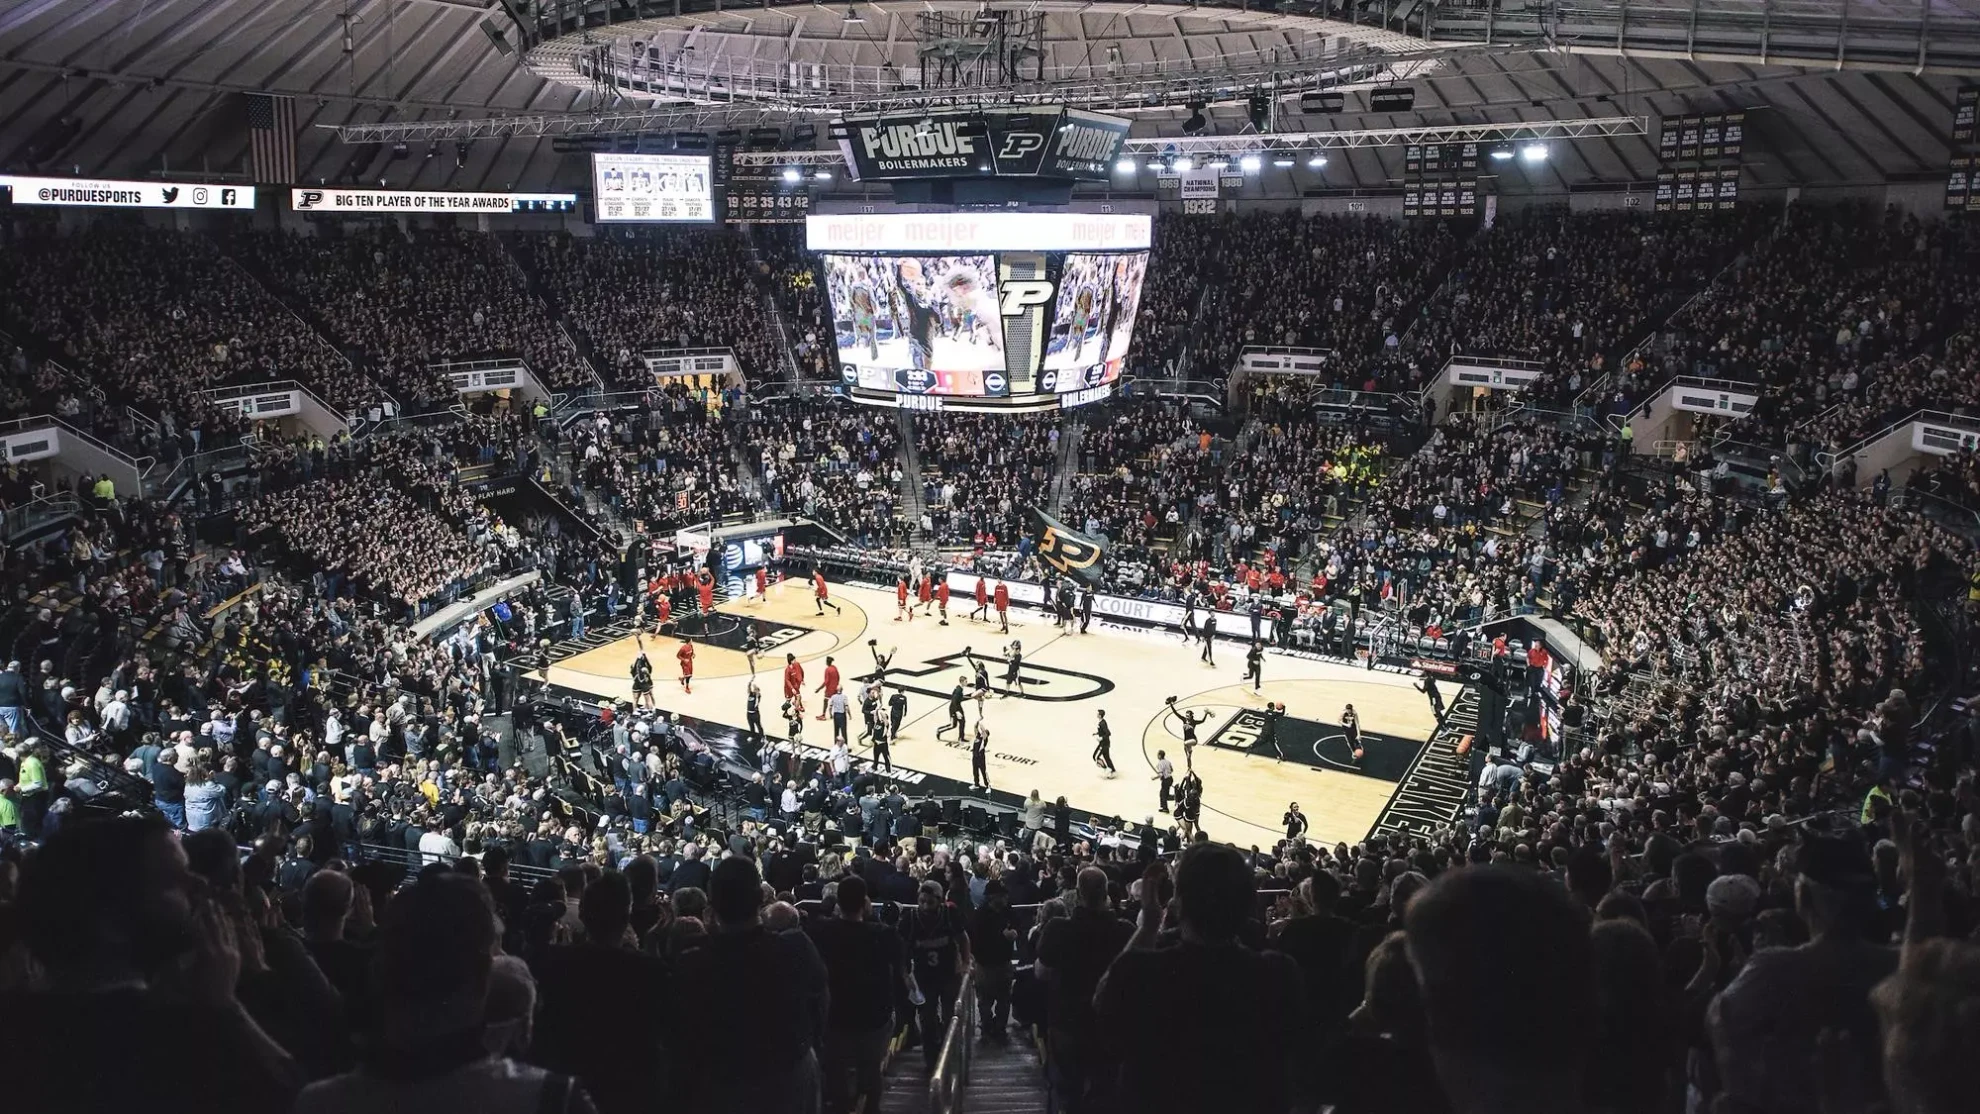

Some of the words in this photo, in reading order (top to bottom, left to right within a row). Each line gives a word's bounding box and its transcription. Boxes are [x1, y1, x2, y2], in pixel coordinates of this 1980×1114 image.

[861, 121, 974, 158] PURDUE
[1056, 125, 1120, 161] PURDUE
[878, 157, 967, 170] BOILERMAKERS
[38, 187, 142, 203] @PURDUESPORTS
[336, 195, 353, 206] BIG
[355, 195, 373, 206] TEN
[376, 196, 411, 207] PLAYER
[414, 196, 426, 207] OF
[428, 197, 445, 207] THE
[447, 197, 470, 208] YEAR
[472, 198, 509, 208] AWARDS
[727, 196, 739, 208] 19
[743, 196, 757, 208] 32
[760, 196, 774, 208] 35
[777, 196, 792, 208] 43
[794, 196, 809, 208] 42
[1183, 200, 1216, 214] 1932
[828, 219, 885, 247] meijer
[904, 218, 979, 247] meijer
[1072, 219, 1115, 247] meijer
[1000, 280, 1054, 316] P
[896, 394, 943, 411] PURDUE
[1062, 384, 1112, 408] BOILERMAKERS
[478, 491, 495, 500] PLAY
[497, 487, 516, 496] HARD
[1100, 598, 1154, 619] COURT
[994, 752, 1040, 766] COURT
[927, 951, 939, 967] 3
